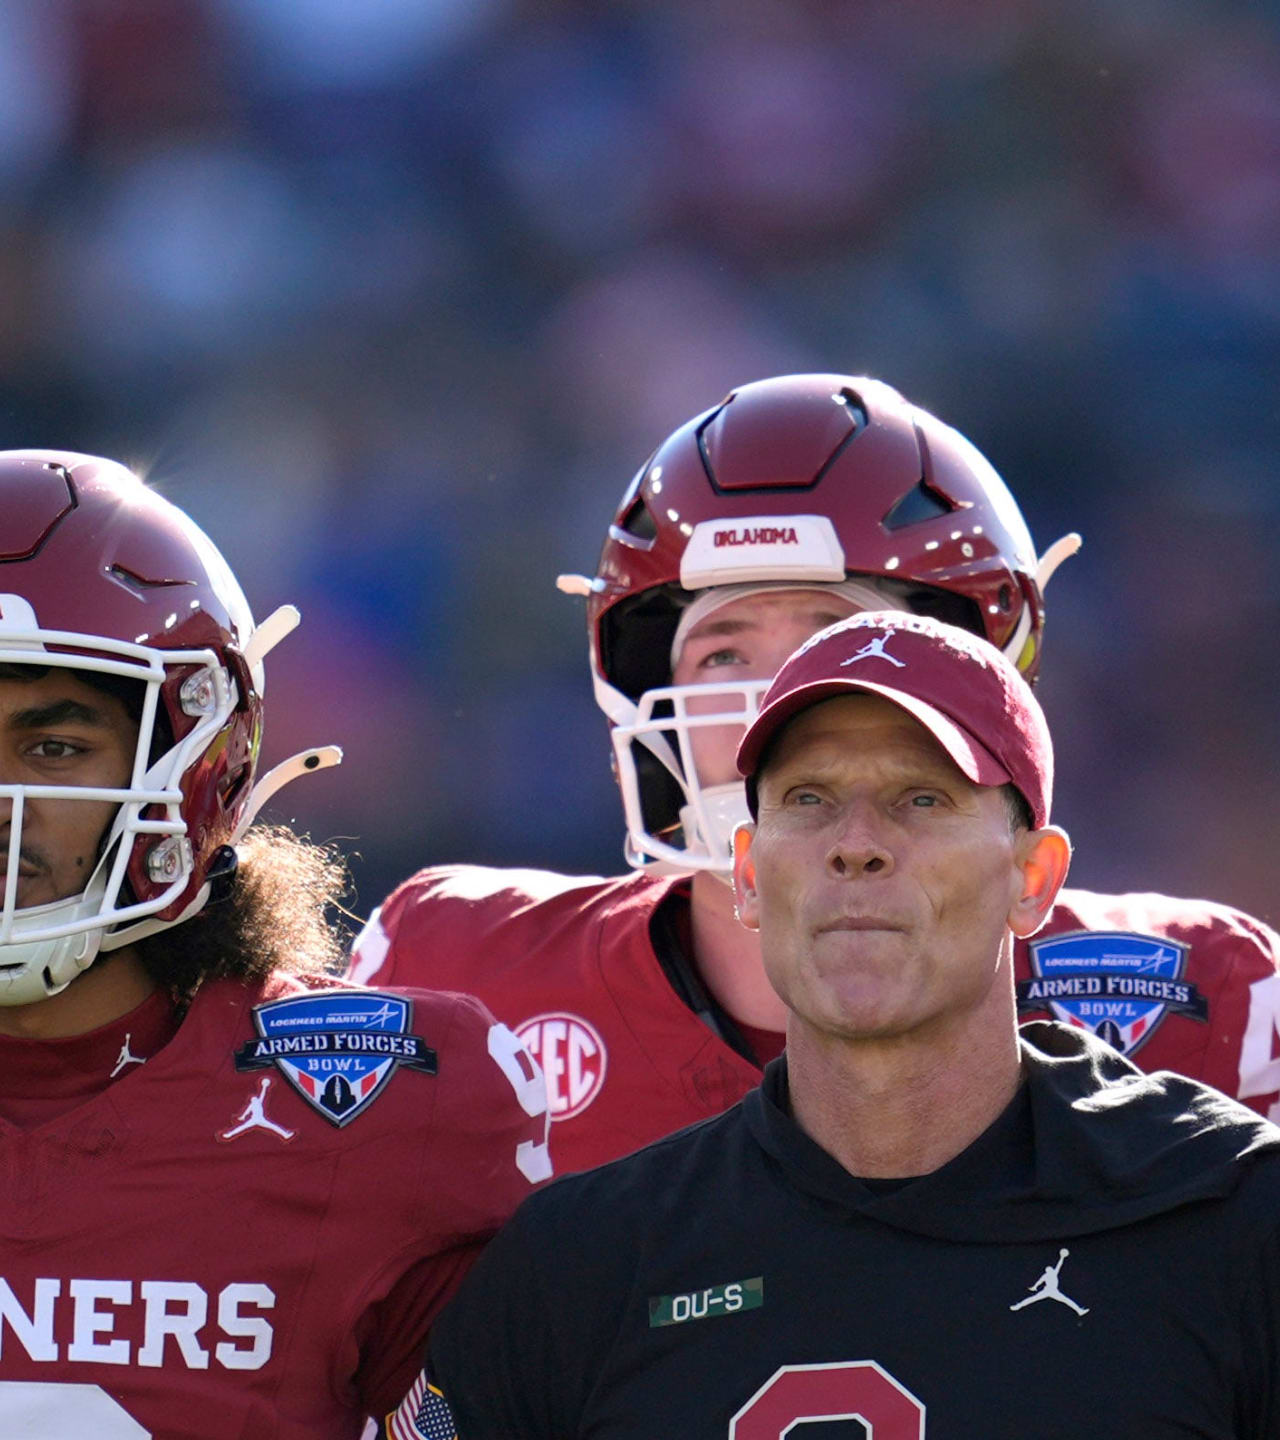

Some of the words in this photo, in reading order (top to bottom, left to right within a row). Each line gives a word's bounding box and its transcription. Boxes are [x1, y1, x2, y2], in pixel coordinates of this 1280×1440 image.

[714, 527, 799, 548] OKLAHOMA
[1027, 976, 1101, 1000] ARMED
[1106, 976, 1190, 1002] FORCES
[1079, 1001, 1137, 1017] BOWL
[270, 1017, 323, 1027] LOCKHEED
[326, 1015, 368, 1024] MARTIN
[254, 1034, 328, 1057] ARMED
[334, 1032, 417, 1056] FORCES
[308, 1058, 366, 1071] BOWL
[487, 1022, 554, 1185] 9
[672, 1284, 744, 1321] OU-S
